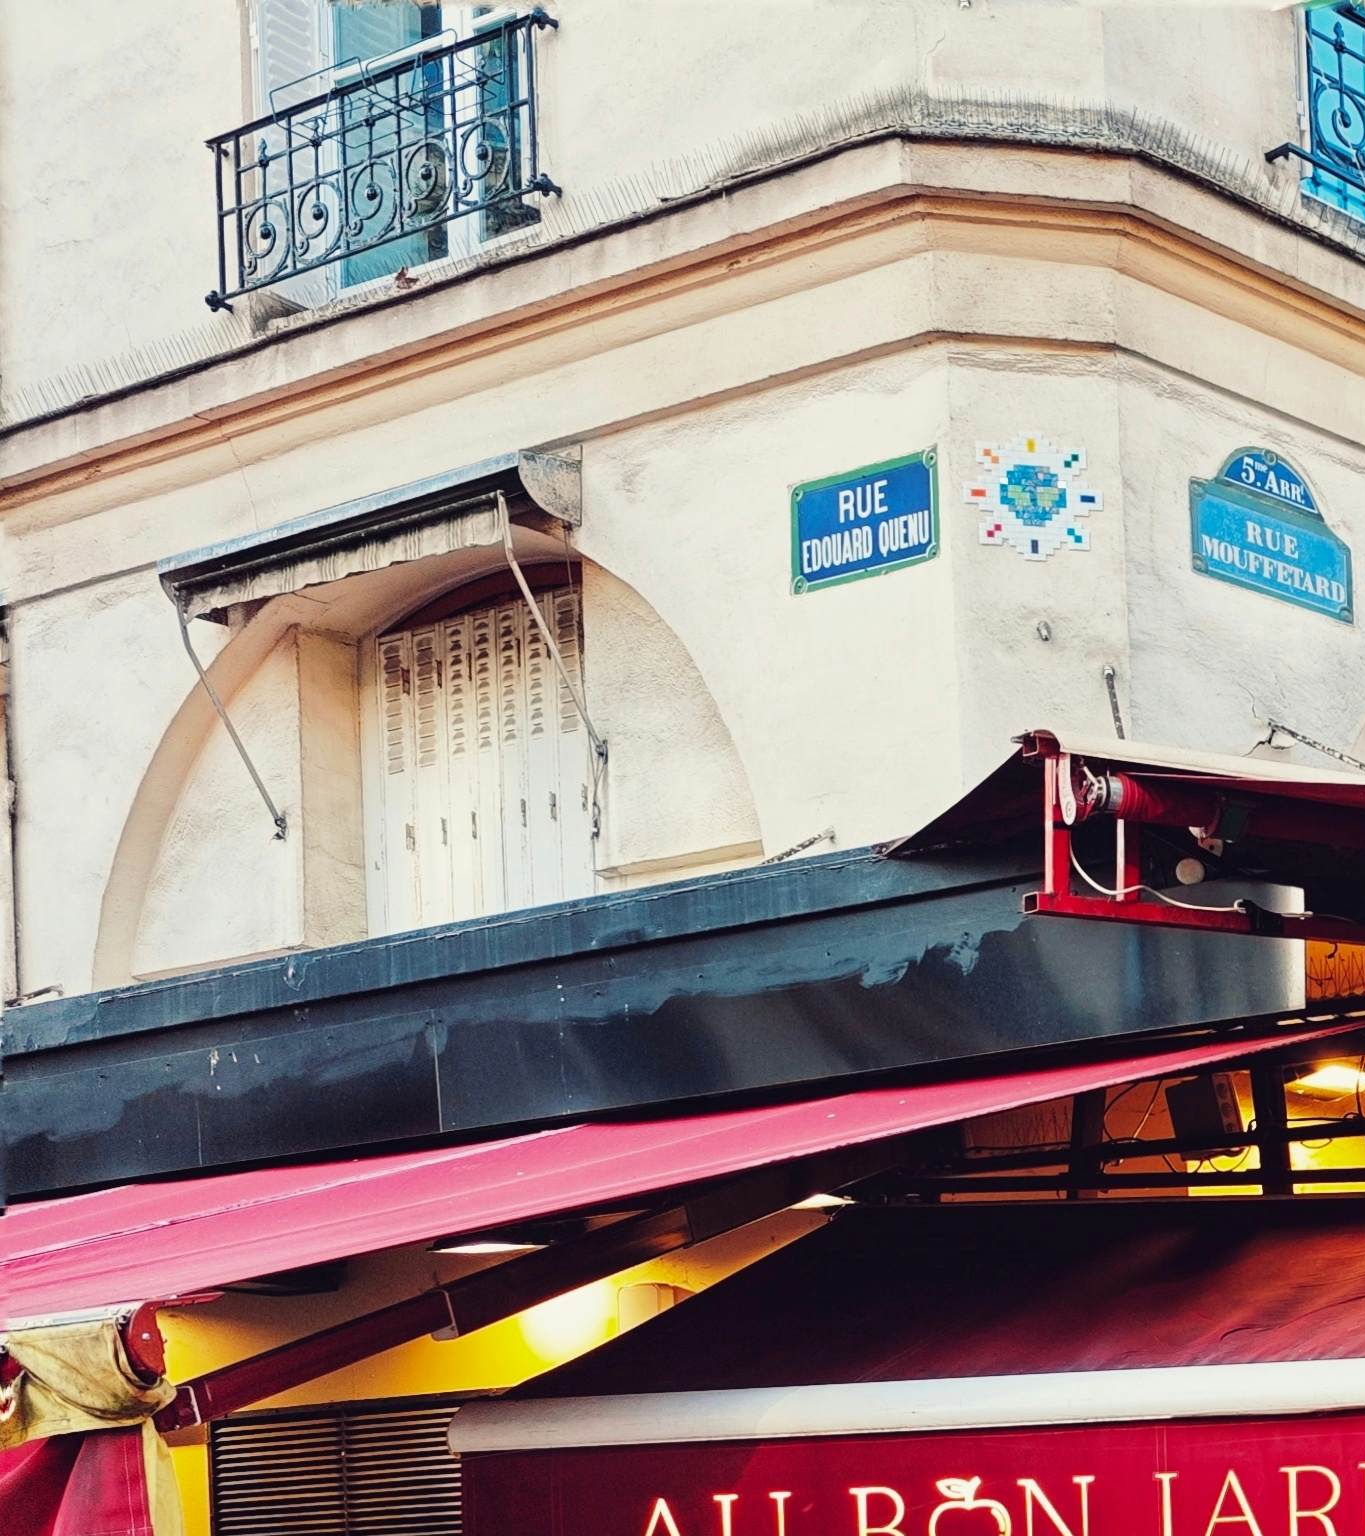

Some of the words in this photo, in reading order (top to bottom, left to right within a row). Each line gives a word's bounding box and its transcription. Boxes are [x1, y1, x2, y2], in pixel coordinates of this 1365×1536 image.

[838, 479, 889, 523] RUE
[802, 525, 873, 574] EDOUARD
[878, 510, 929, 558] QUENU
[1246, 520, 1299, 560] RUE
[1201, 534, 1346, 603] MOUFFETARD
